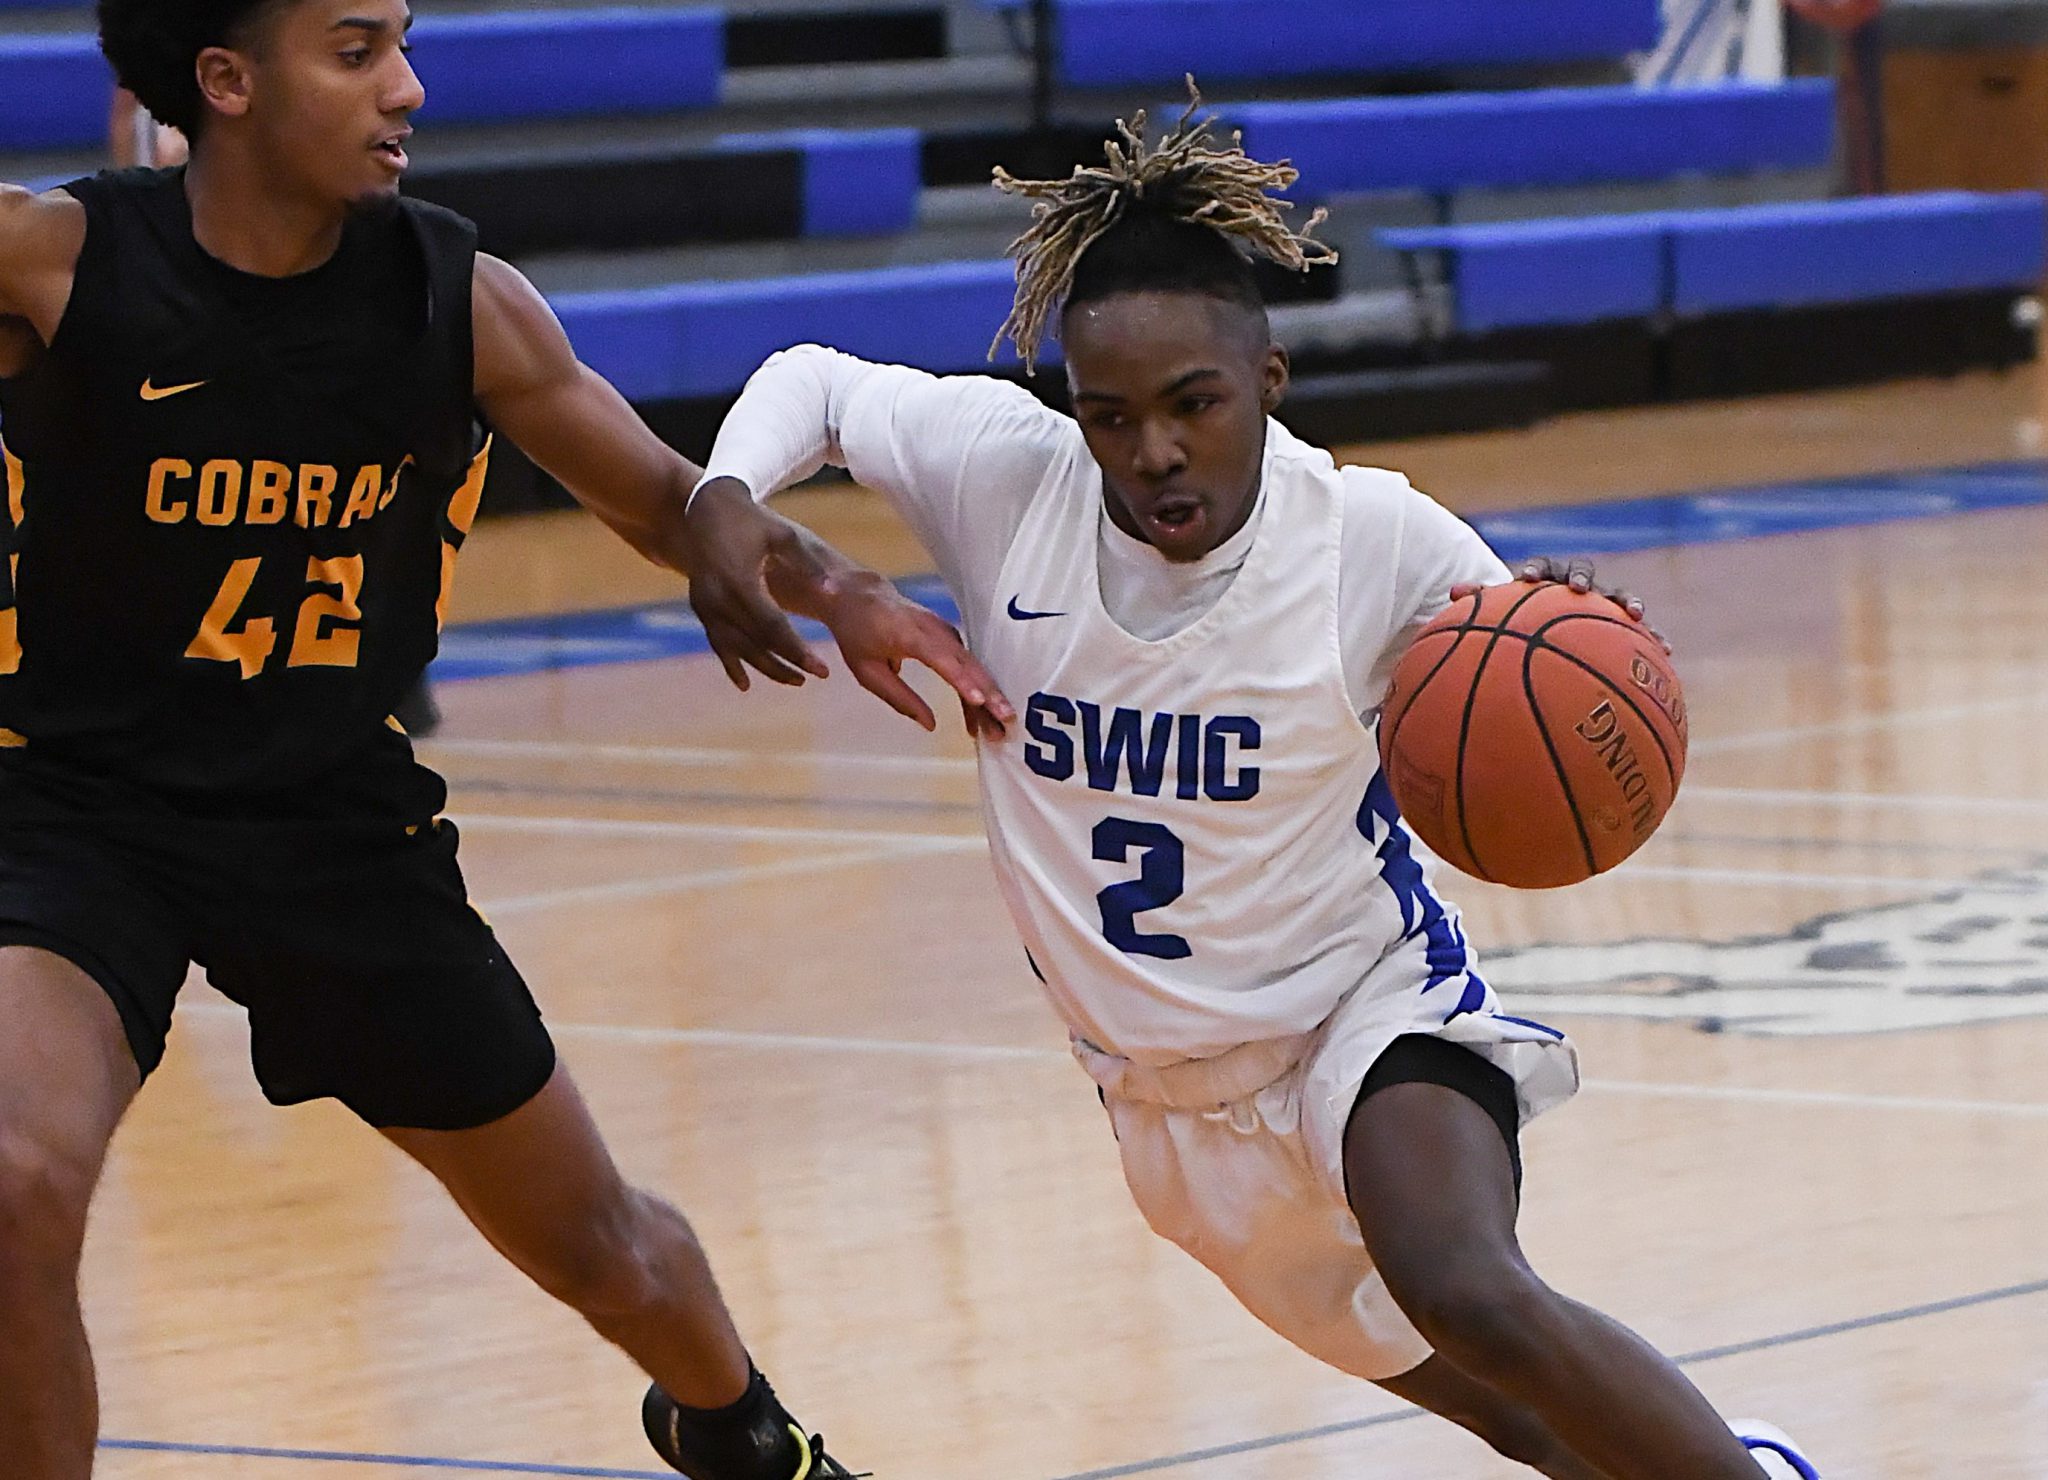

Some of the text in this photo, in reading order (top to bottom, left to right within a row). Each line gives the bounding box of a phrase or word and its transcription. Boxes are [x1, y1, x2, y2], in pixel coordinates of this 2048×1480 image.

[184, 553, 364, 680] 42
[1024, 691, 1261, 801] SWIC
[1092, 815, 1193, 960] 2
